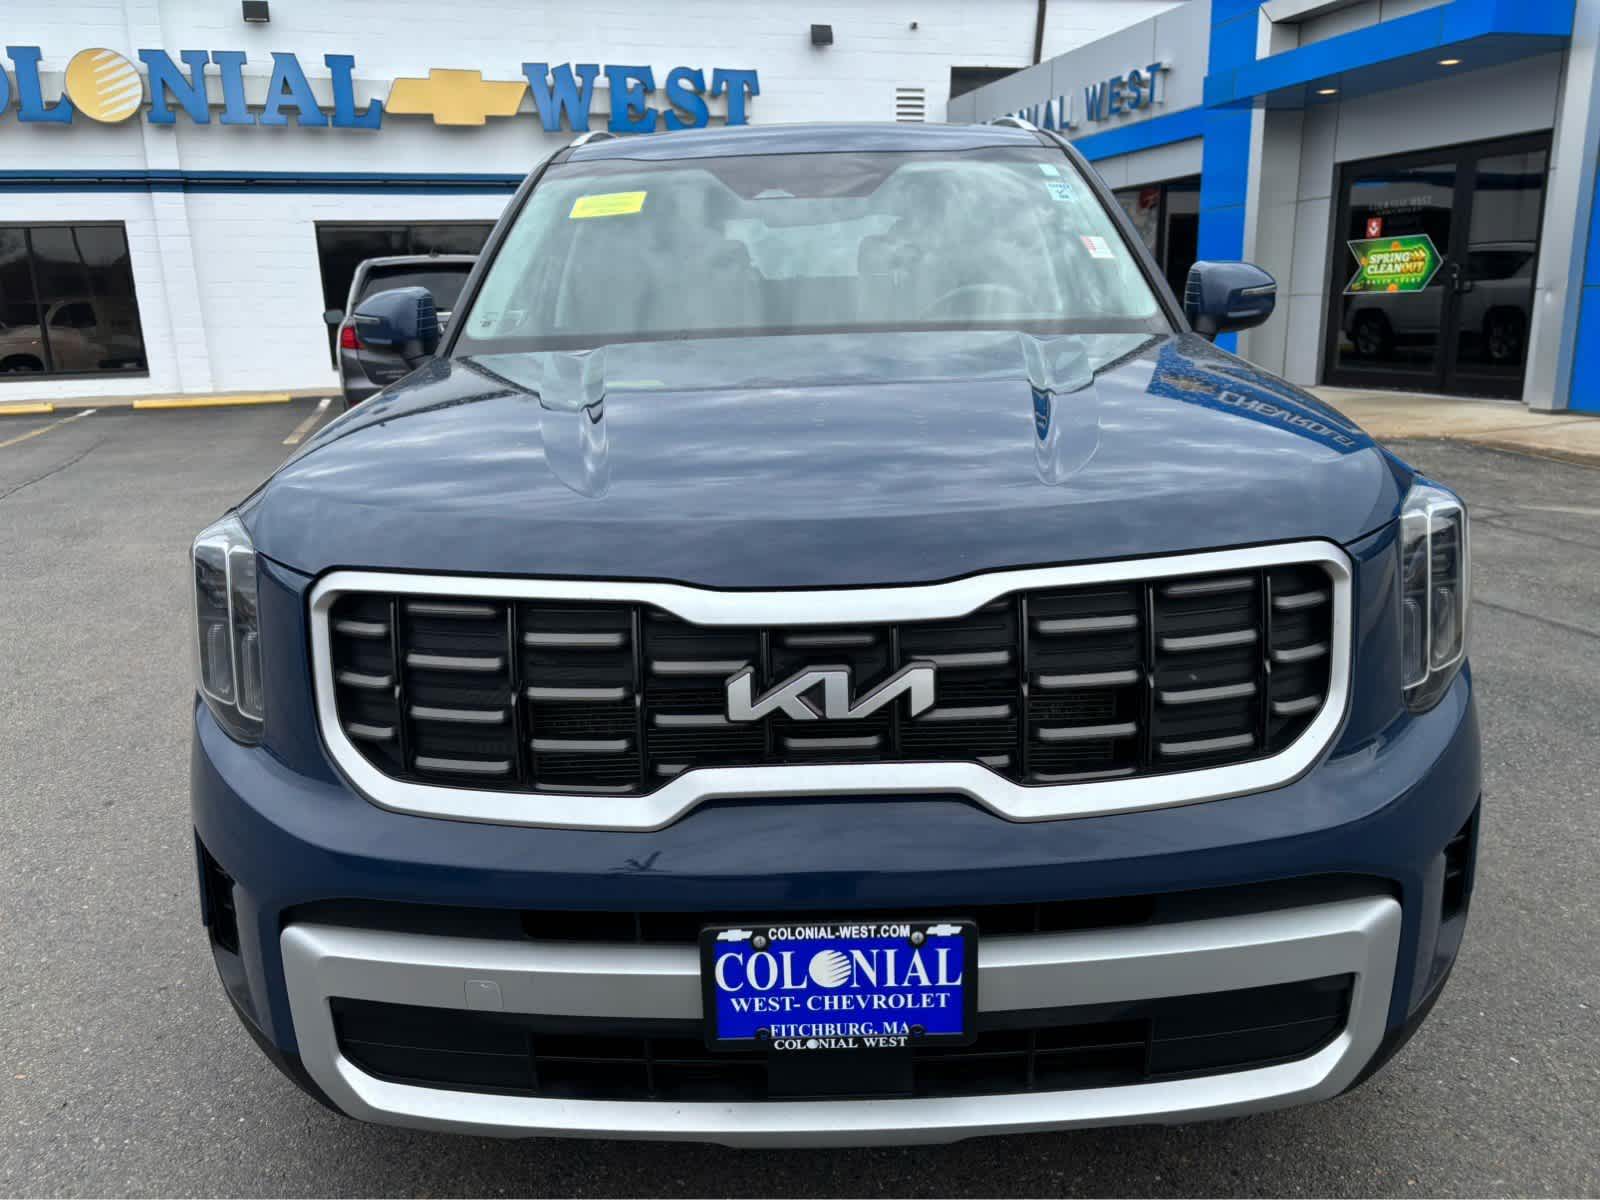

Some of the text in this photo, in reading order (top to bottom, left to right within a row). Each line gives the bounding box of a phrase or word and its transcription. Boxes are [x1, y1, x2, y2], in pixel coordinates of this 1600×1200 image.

[0, 45, 760, 133] LONIAL WEST
[1084, 62, 1163, 122] WEST
[1369, 252, 1411, 263] SPRING
[768, 925, 911, 941] COLONIAL-WEST.COM
[715, 948, 963, 992] COLONIAL
[730, 992, 951, 1013] WEST- CHEVROLET
[882, 1021, 910, 1035] MA
[774, 1036, 908, 1050] COLONIAL WEST
